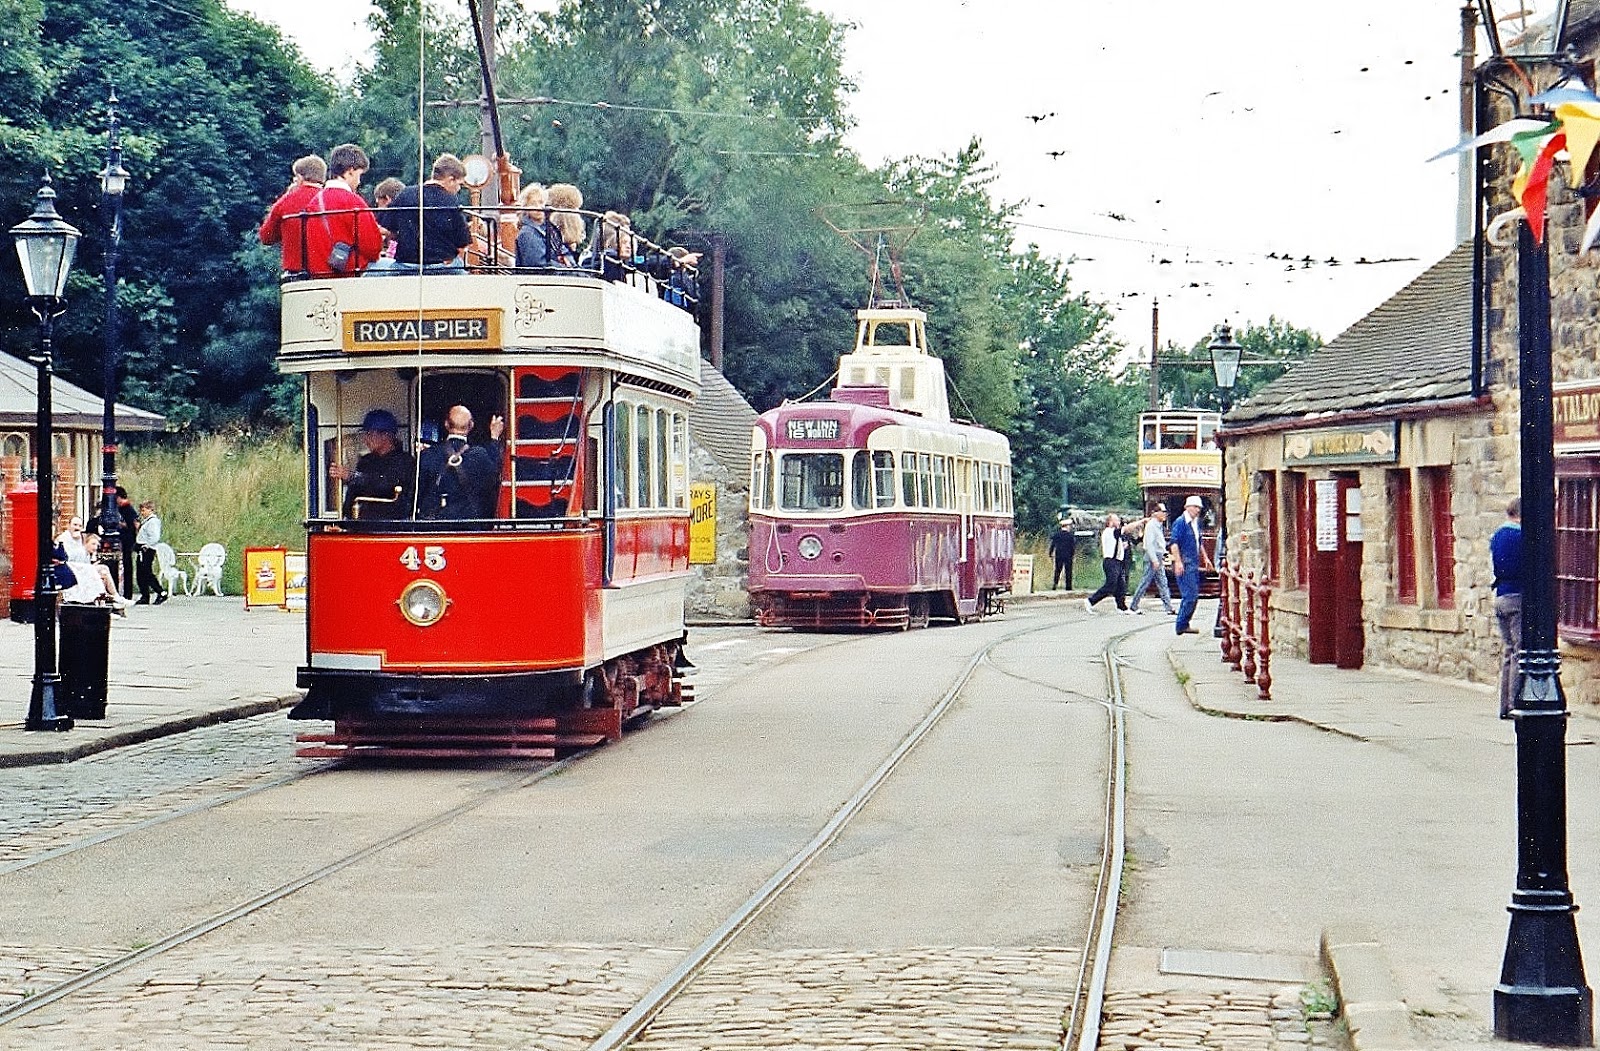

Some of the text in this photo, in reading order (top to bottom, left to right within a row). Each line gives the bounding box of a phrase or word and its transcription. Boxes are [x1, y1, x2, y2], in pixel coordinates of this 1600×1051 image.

[360, 319, 483, 341] ROYAL PIER
[788, 420, 838, 430] NEW INN
[1144, 465, 1215, 478] MELBOURNE
[399, 546, 447, 571] 45
